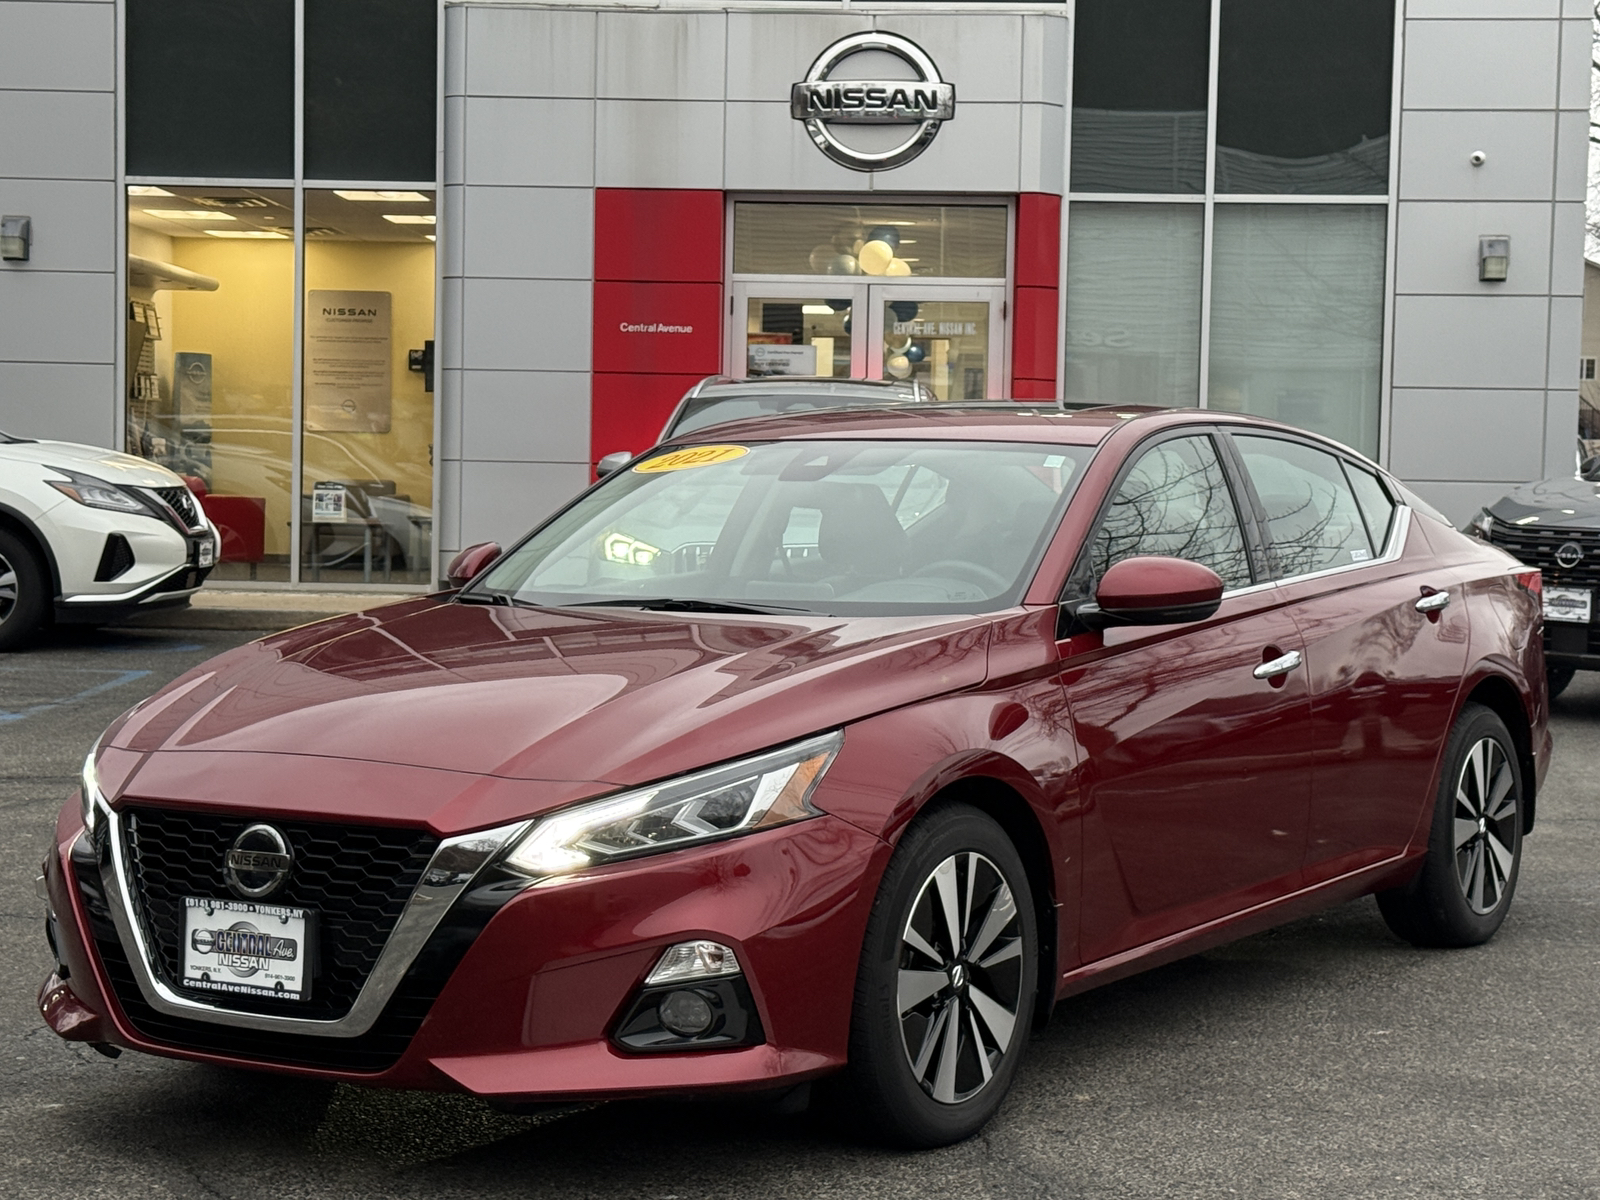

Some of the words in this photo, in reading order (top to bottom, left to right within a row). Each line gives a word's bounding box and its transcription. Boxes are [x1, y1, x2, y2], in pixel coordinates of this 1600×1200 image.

[808, 88, 938, 112] NISSAN
[322, 308, 376, 316] NISSAN
[620, 322, 656, 332] Central
[657, 323, 693, 334] Avenue
[939, 322, 963, 336] NISSAN
[646, 449, 736, 470] 2021
[230, 854, 281, 868] NISSAN
[210, 900, 248, 912] 961-3900
[216, 929, 272, 956] CENTRAL
[272, 940, 294, 958] Ave.
[190, 964, 212, 972] YONKERS,
[218, 953, 270, 970] NISSAN
[264, 974, 296, 982] 914-961-3900
[184, 979, 300, 1000] CentralAveNissan.com
